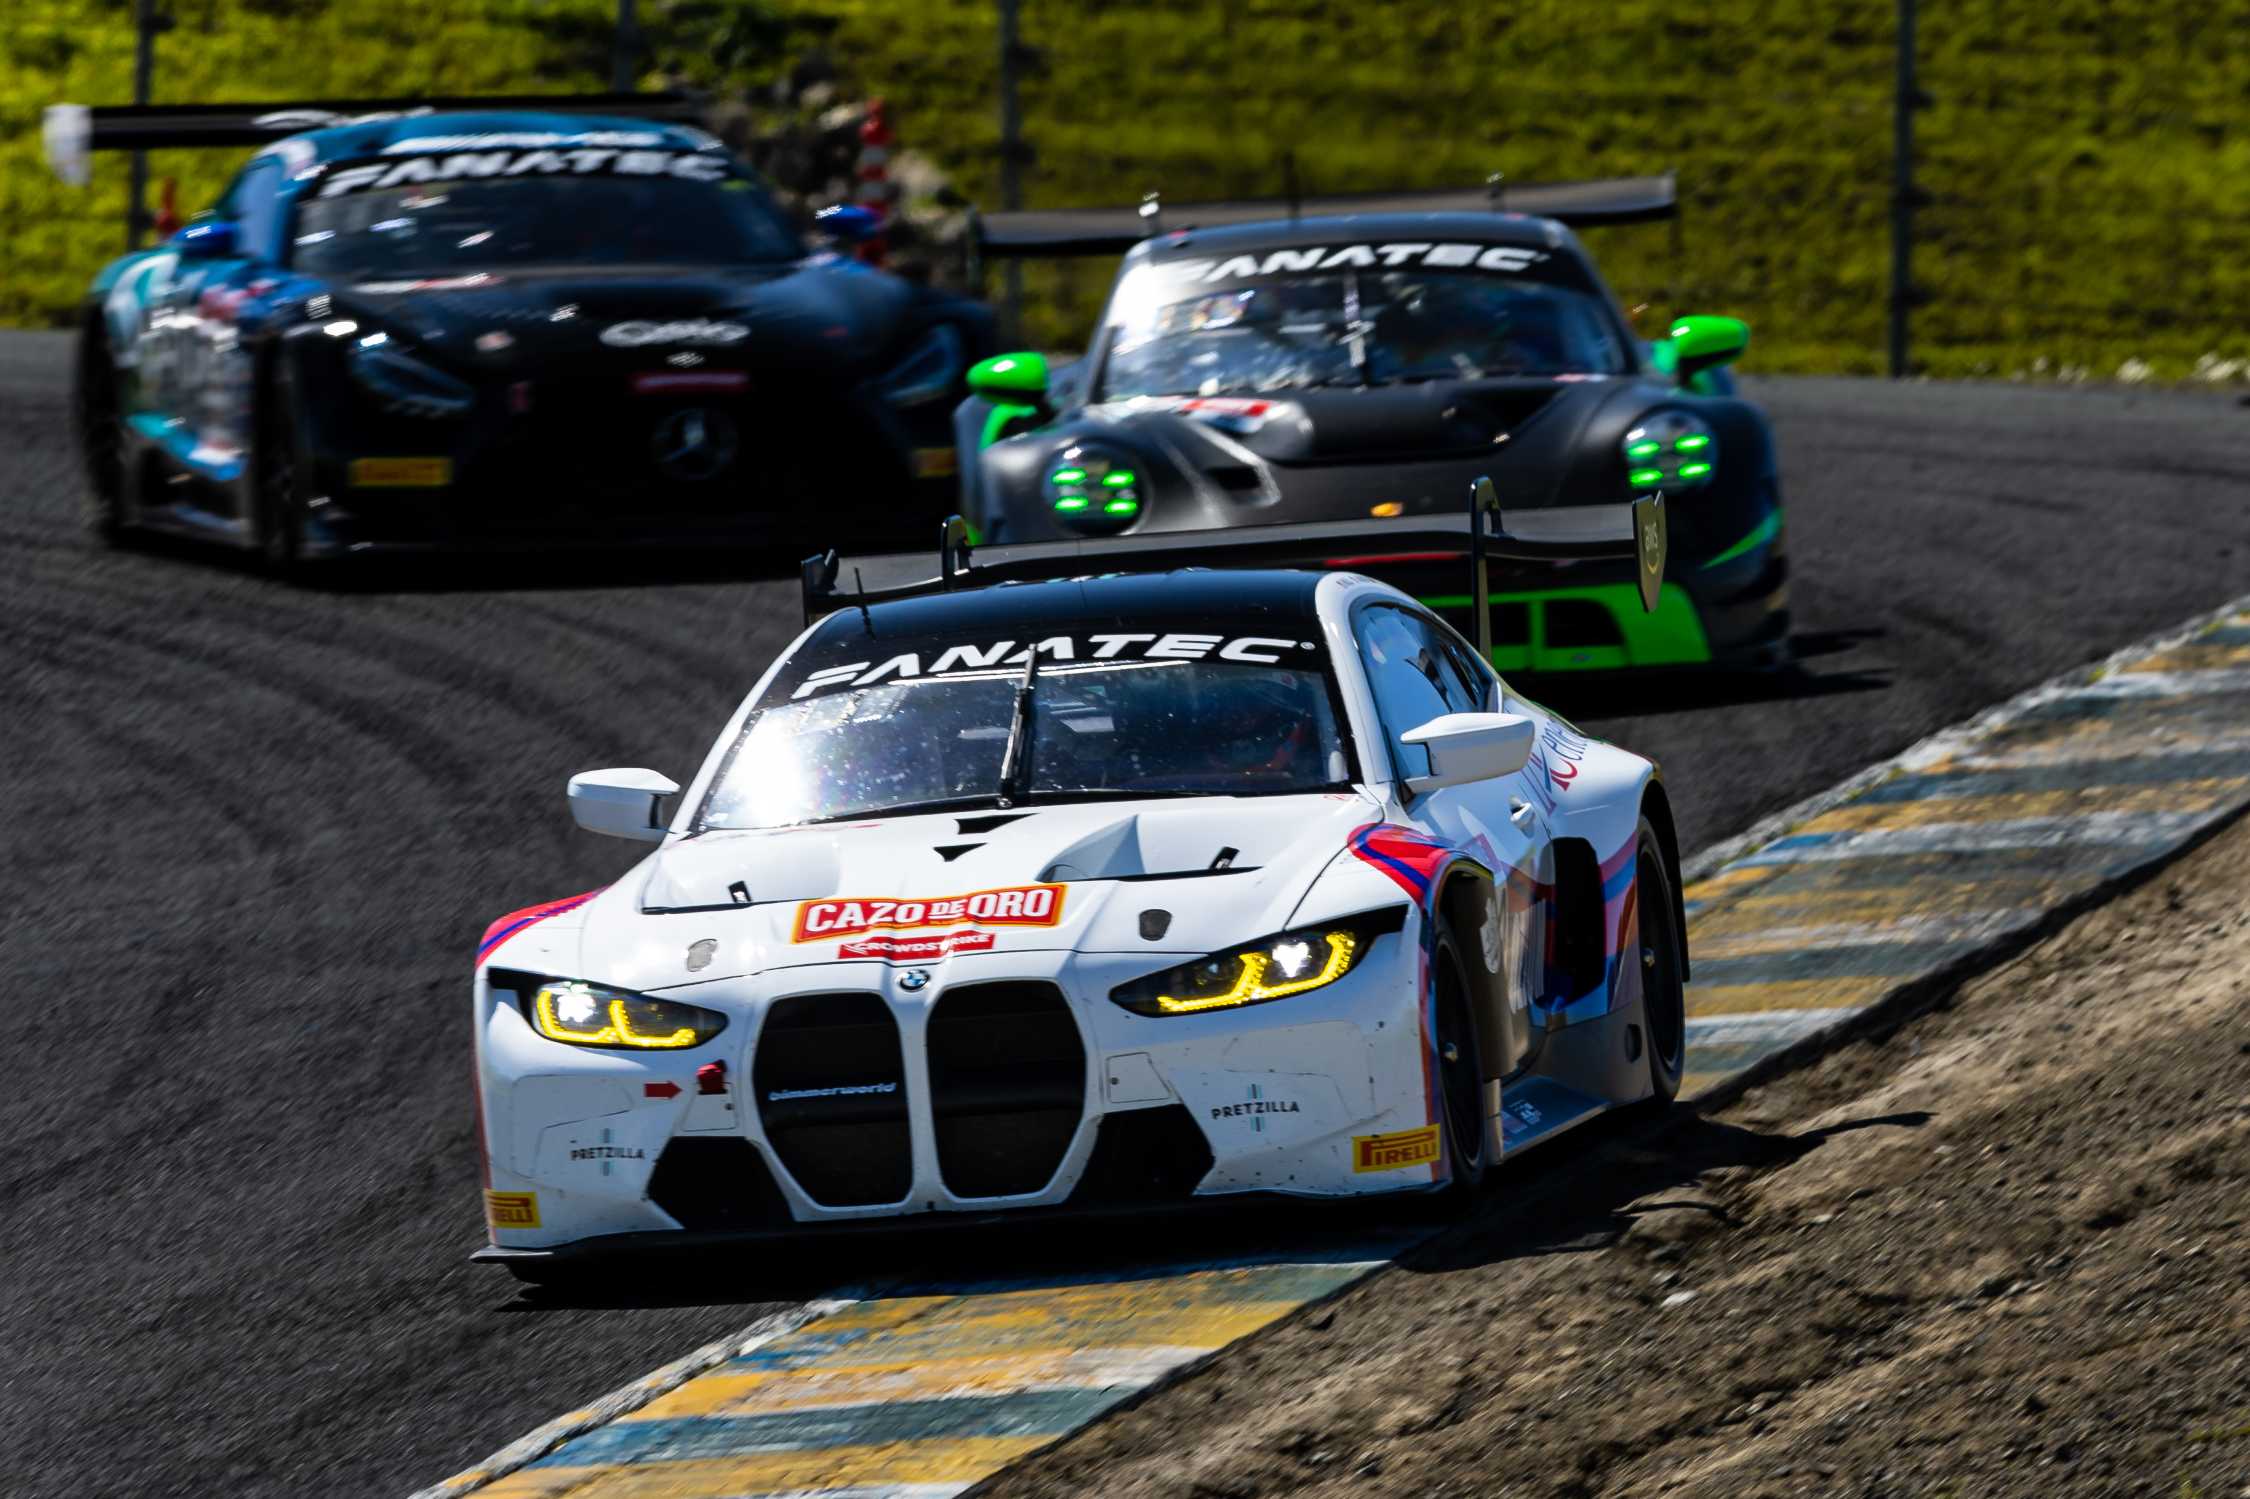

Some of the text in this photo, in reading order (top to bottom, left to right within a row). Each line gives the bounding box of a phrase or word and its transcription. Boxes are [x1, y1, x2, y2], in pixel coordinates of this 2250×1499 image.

[319, 150, 729, 198] FANATEC
[806, 888, 1054, 932] CAZO DE ORO
[1211, 1100, 1300, 1120] PRETZILLA
[570, 1146, 645, 1161] PRETZILLA
[1360, 1130, 1438, 1167] PIRELLI
